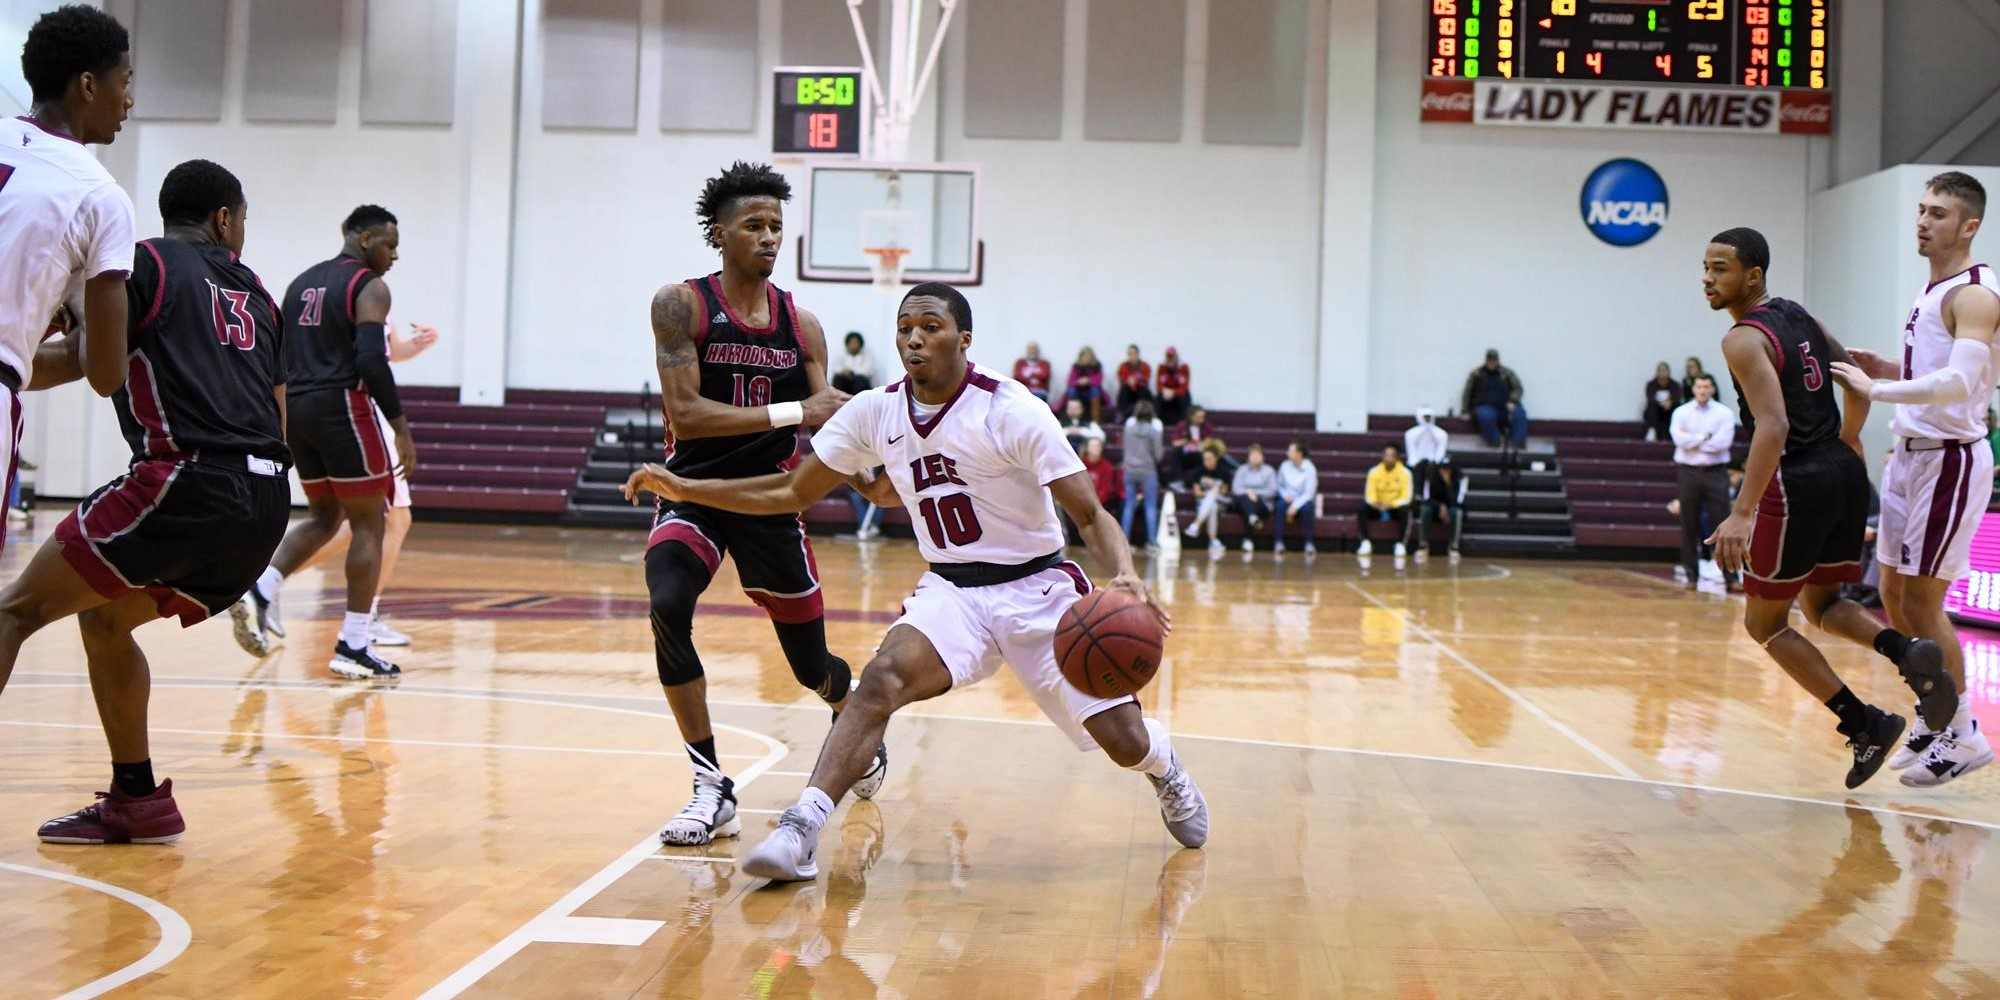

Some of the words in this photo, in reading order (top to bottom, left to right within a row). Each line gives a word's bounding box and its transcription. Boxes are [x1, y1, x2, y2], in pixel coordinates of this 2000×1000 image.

[1499, 19, 1512, 37] 0
[1589, 13, 1635, 25] PERIOD
[1648, 9, 1656, 31] 1
[1746, 7, 1769, 24] 03
[1778, 8, 1792, 26] 0
[1811, 9, 1824, 27] 2
[1784, 29, 1792, 46] 1
[1432, 58, 1455, 77] 21
[1556, 51, 1565, 73] 1
[1586, 52, 1602, 74] 4
[1656, 54, 1671, 77] 4
[1697, 55, 1713, 78] 5
[1745, 68, 1768, 87] 21
[1783, 69, 1791, 87] 1
[797, 77, 854, 105] 8:50
[1484, 86, 1598, 122] LADY
[1606, 91, 1774, 128] FLAMES
[808, 113, 838, 148] 18
[1587, 200, 1667, 226] NCAA
[205, 278, 255, 350] 13
[298, 287, 326, 325] 21
[1799, 341, 1823, 391] 5
[732, 373, 772, 407] 10
[910, 453, 968, 493] LEE
[918, 492, 983, 549] 10
